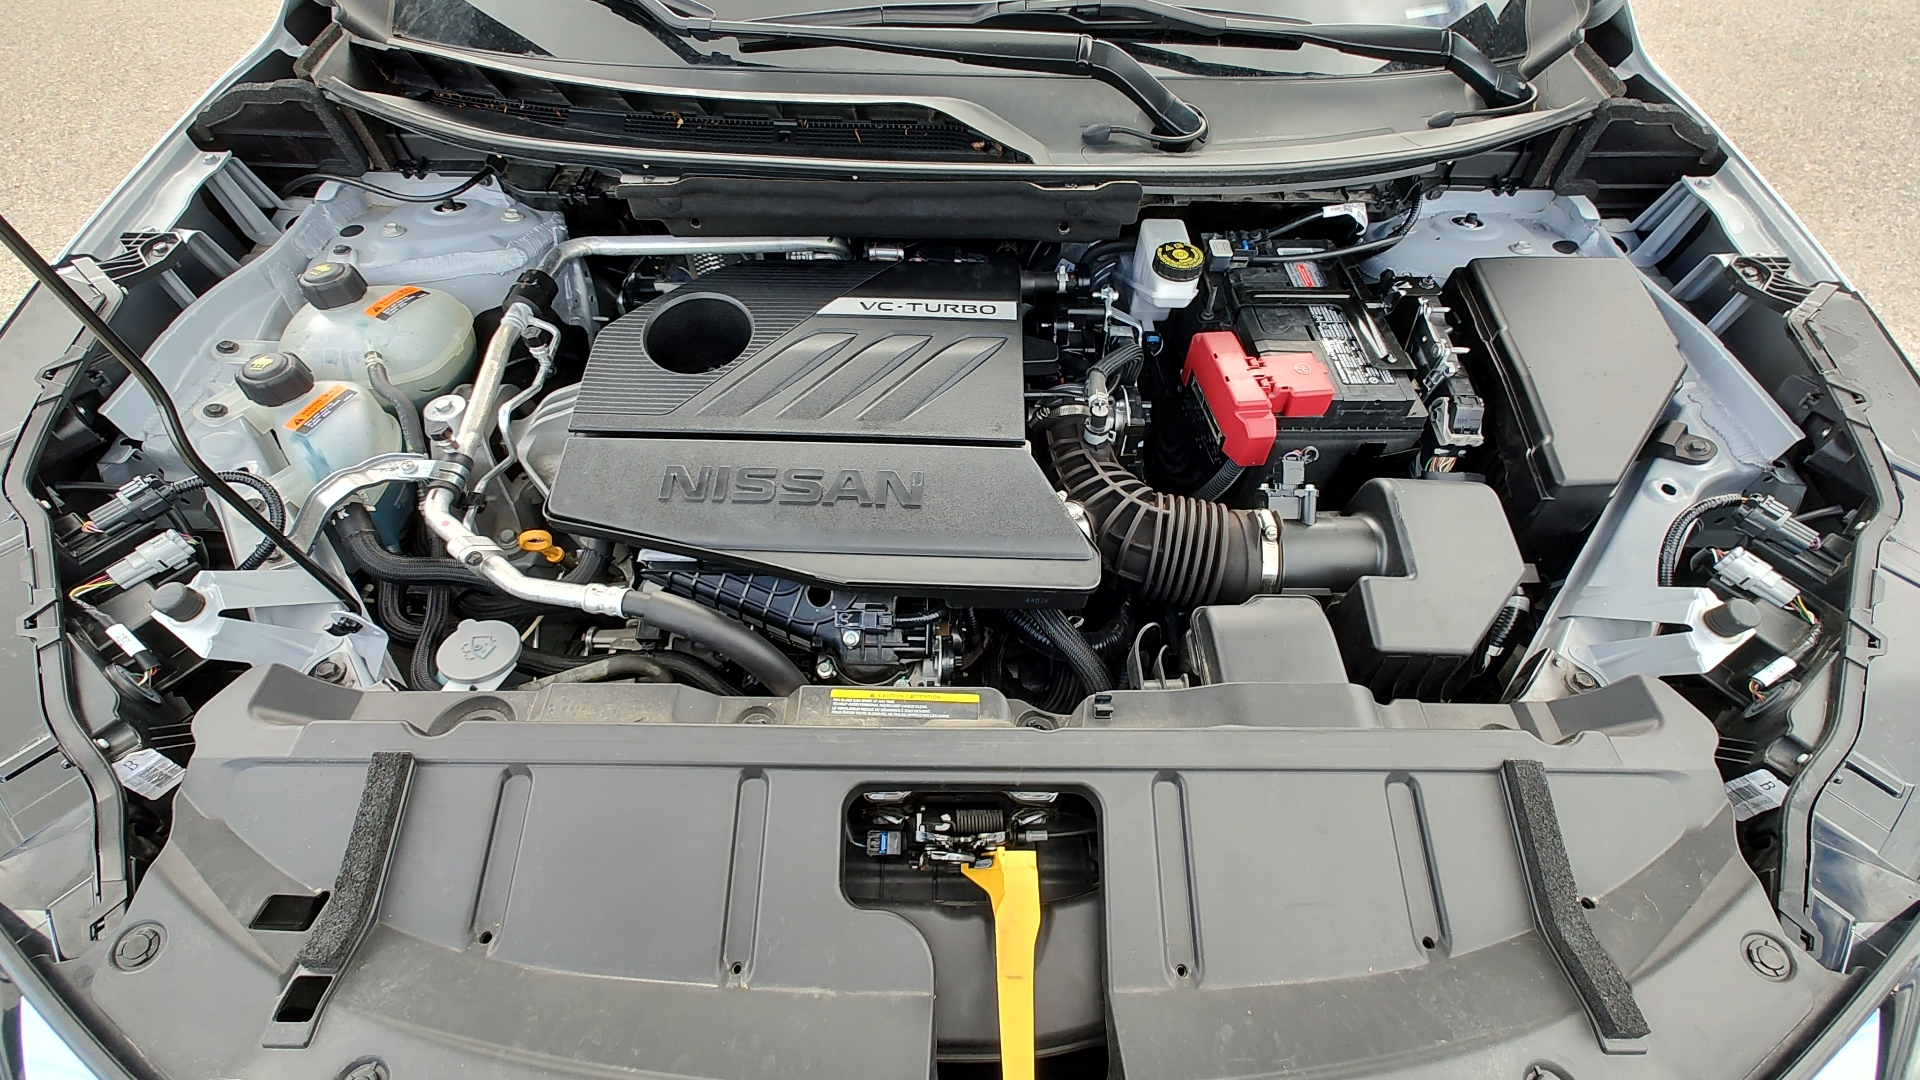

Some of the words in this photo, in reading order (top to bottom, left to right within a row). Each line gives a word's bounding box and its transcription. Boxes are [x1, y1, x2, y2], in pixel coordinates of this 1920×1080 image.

[859, 301, 997, 315] VC-TURBO
[658, 465, 925, 509] NISSAN
[122, 758, 139, 772] B
[1759, 780, 1776, 791] B
